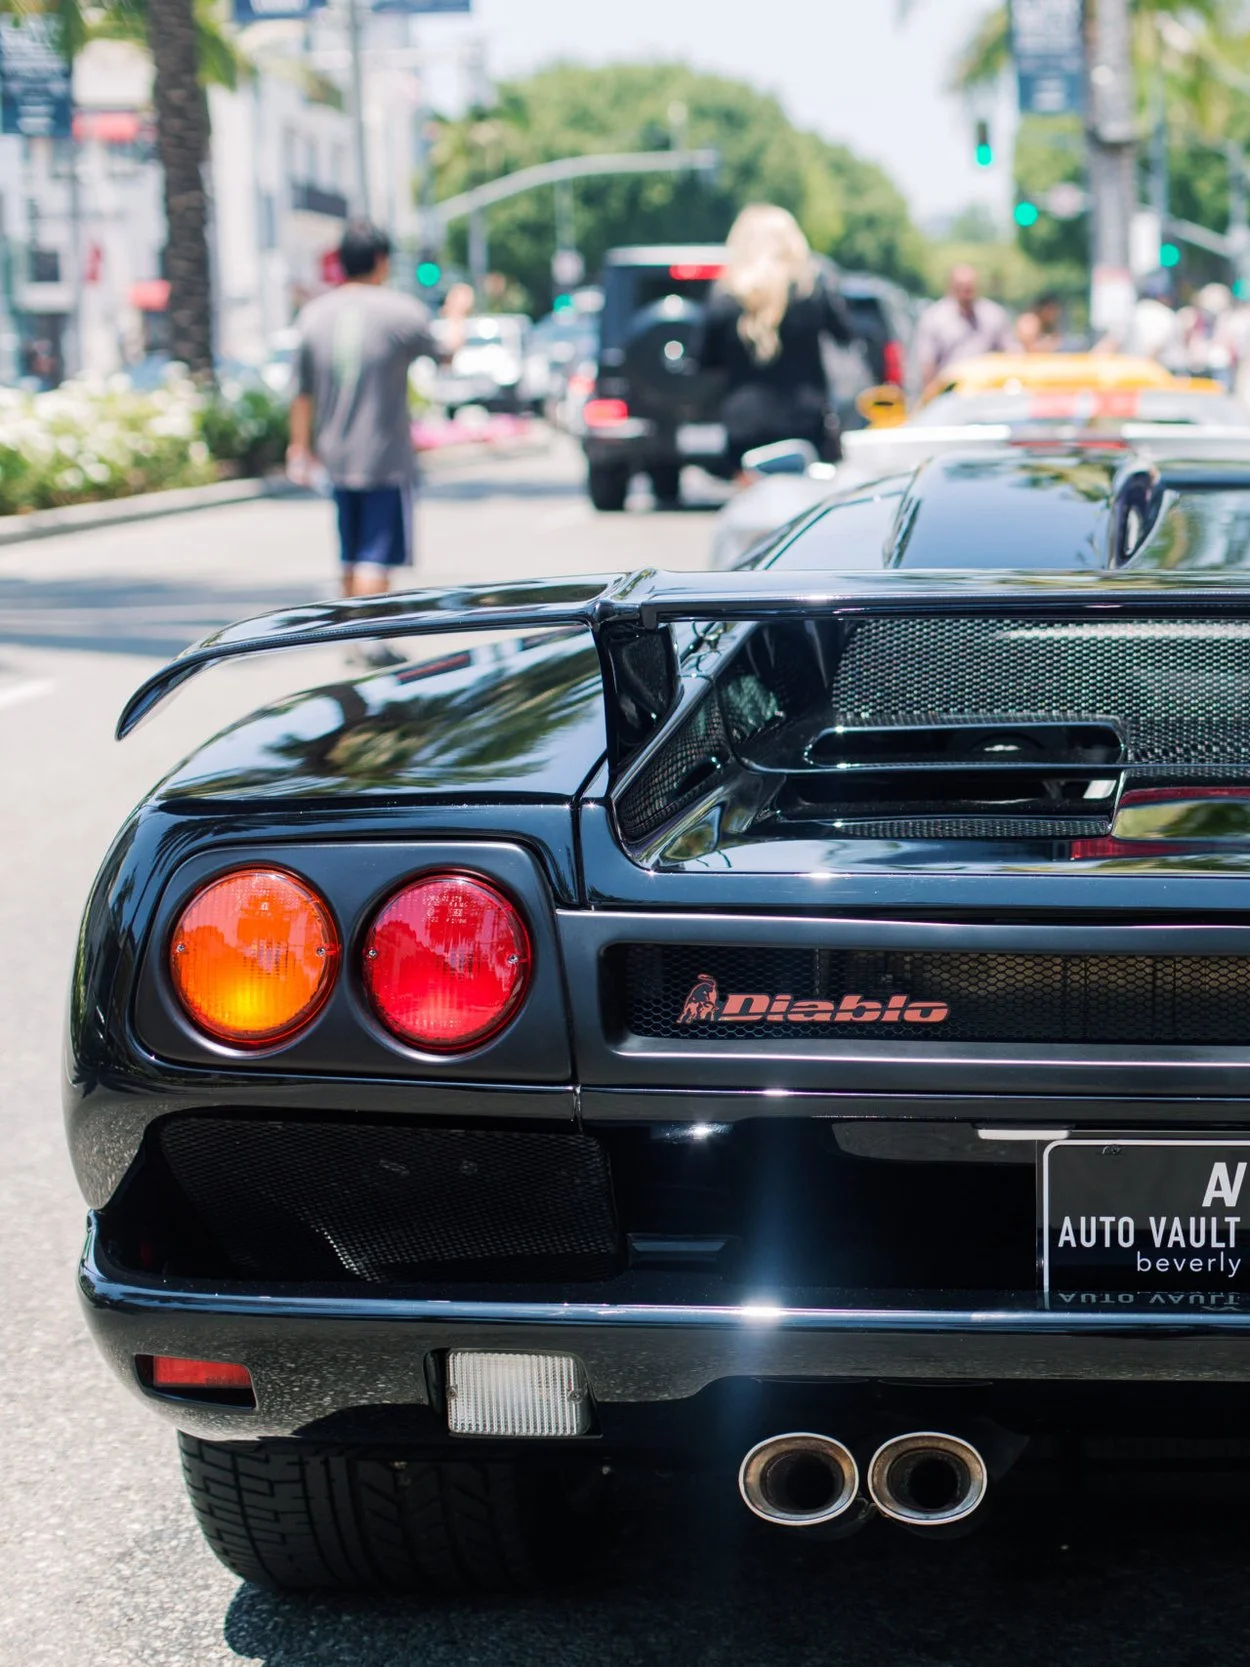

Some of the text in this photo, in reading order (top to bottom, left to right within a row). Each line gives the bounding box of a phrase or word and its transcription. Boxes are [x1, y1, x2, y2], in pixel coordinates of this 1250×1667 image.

[719, 994, 948, 1023] Diablo
[1058, 1215, 1135, 1248] AUTO
[1149, 1216, 1241, 1248] VAULT
[1137, 1251, 1241, 1278] beverly
